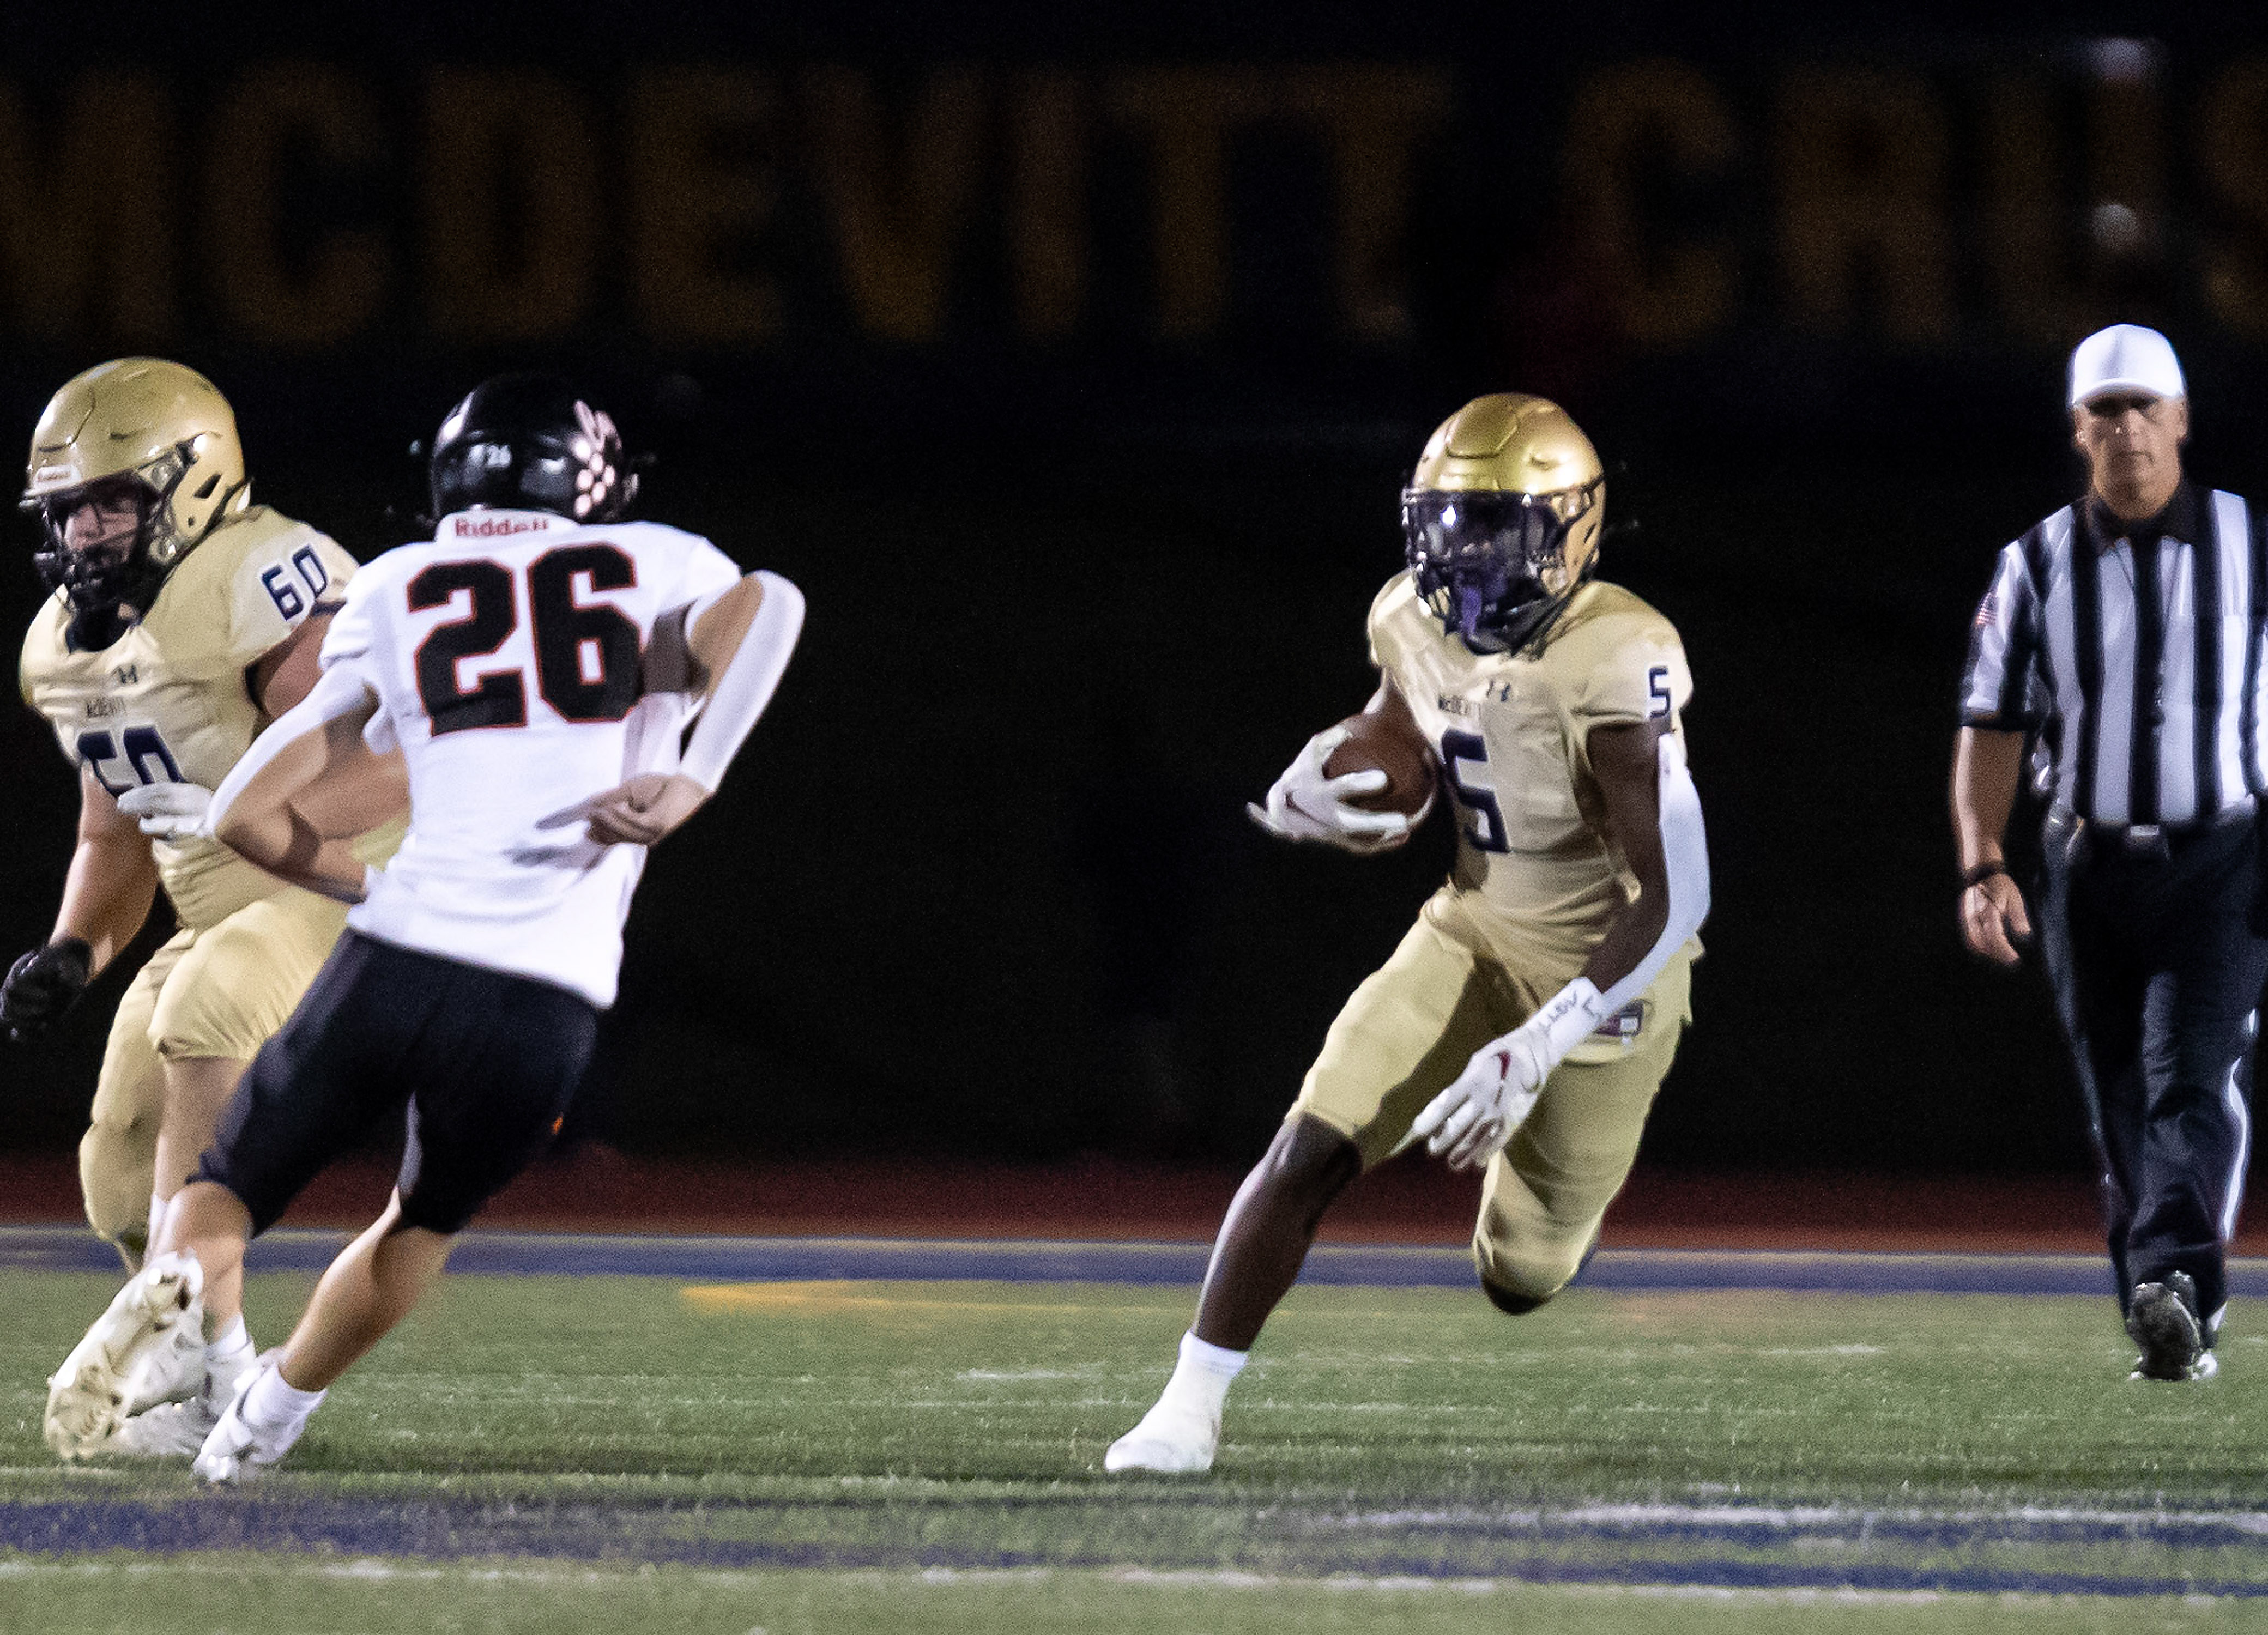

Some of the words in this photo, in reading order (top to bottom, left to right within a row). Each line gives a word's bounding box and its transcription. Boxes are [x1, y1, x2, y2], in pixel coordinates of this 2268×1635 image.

[0, 59, 1455, 344] MCDEVITT
[262, 543, 328, 622] 60
[407, 541, 643, 738] 26
[1648, 665, 1671, 718] 5
[1441, 728, 1511, 853] 5
